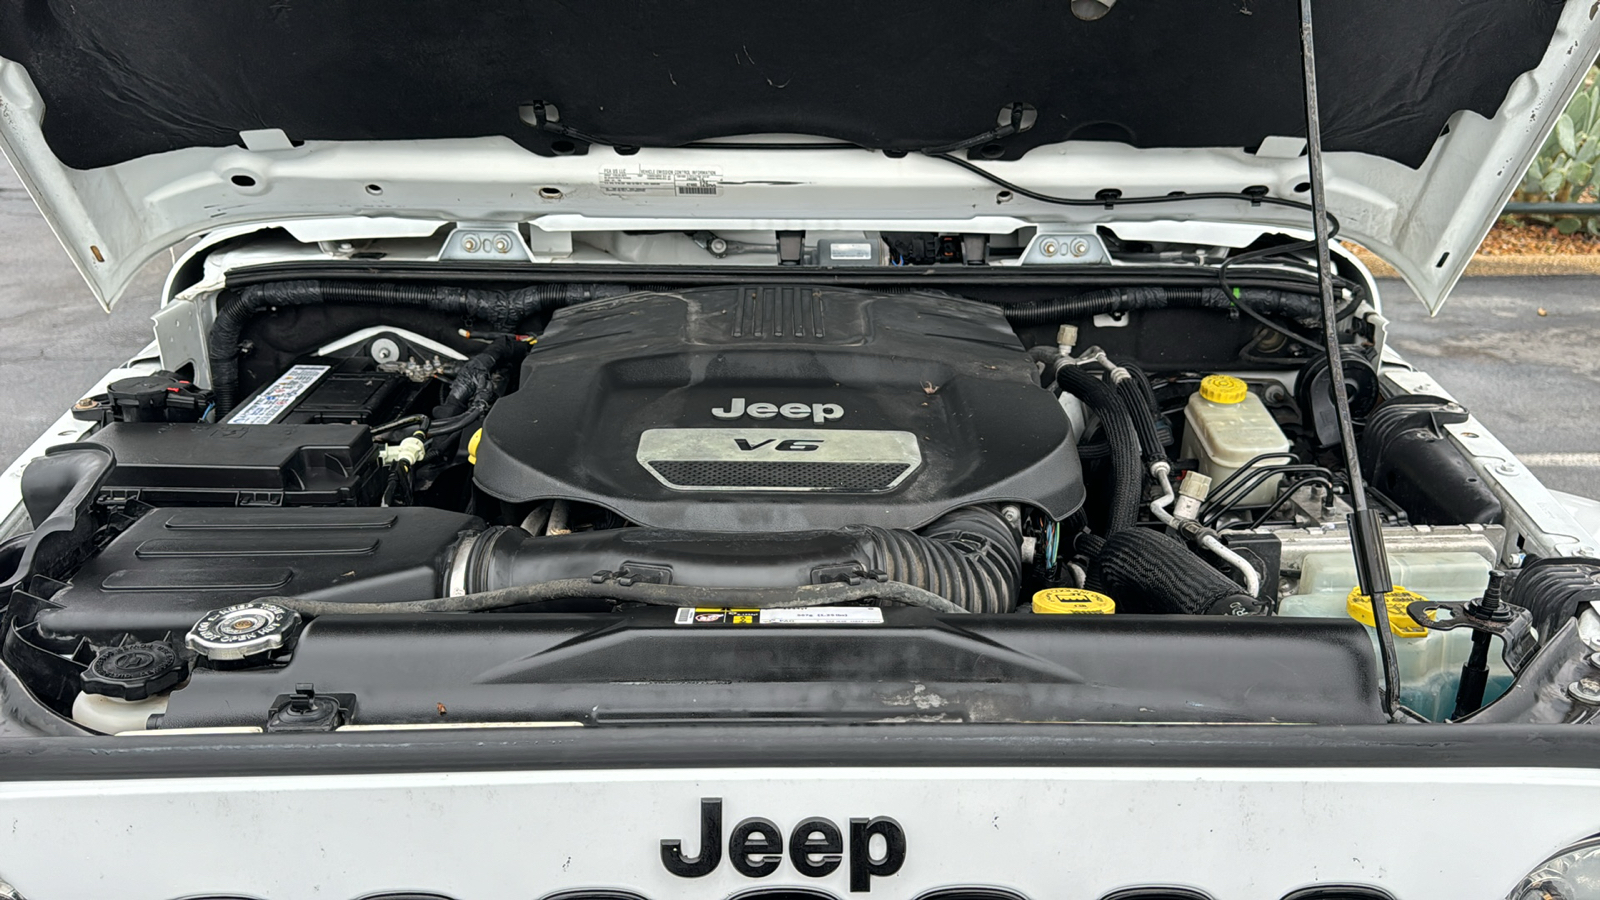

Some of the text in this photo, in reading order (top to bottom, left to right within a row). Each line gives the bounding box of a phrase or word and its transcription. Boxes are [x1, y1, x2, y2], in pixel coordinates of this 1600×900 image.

[711, 398, 845, 424] Jeep
[734, 438, 825, 451] V6
[220, 633, 257, 642] OPEN
[258, 622, 281, 635] HOT
[660, 797, 907, 893] Jeep
